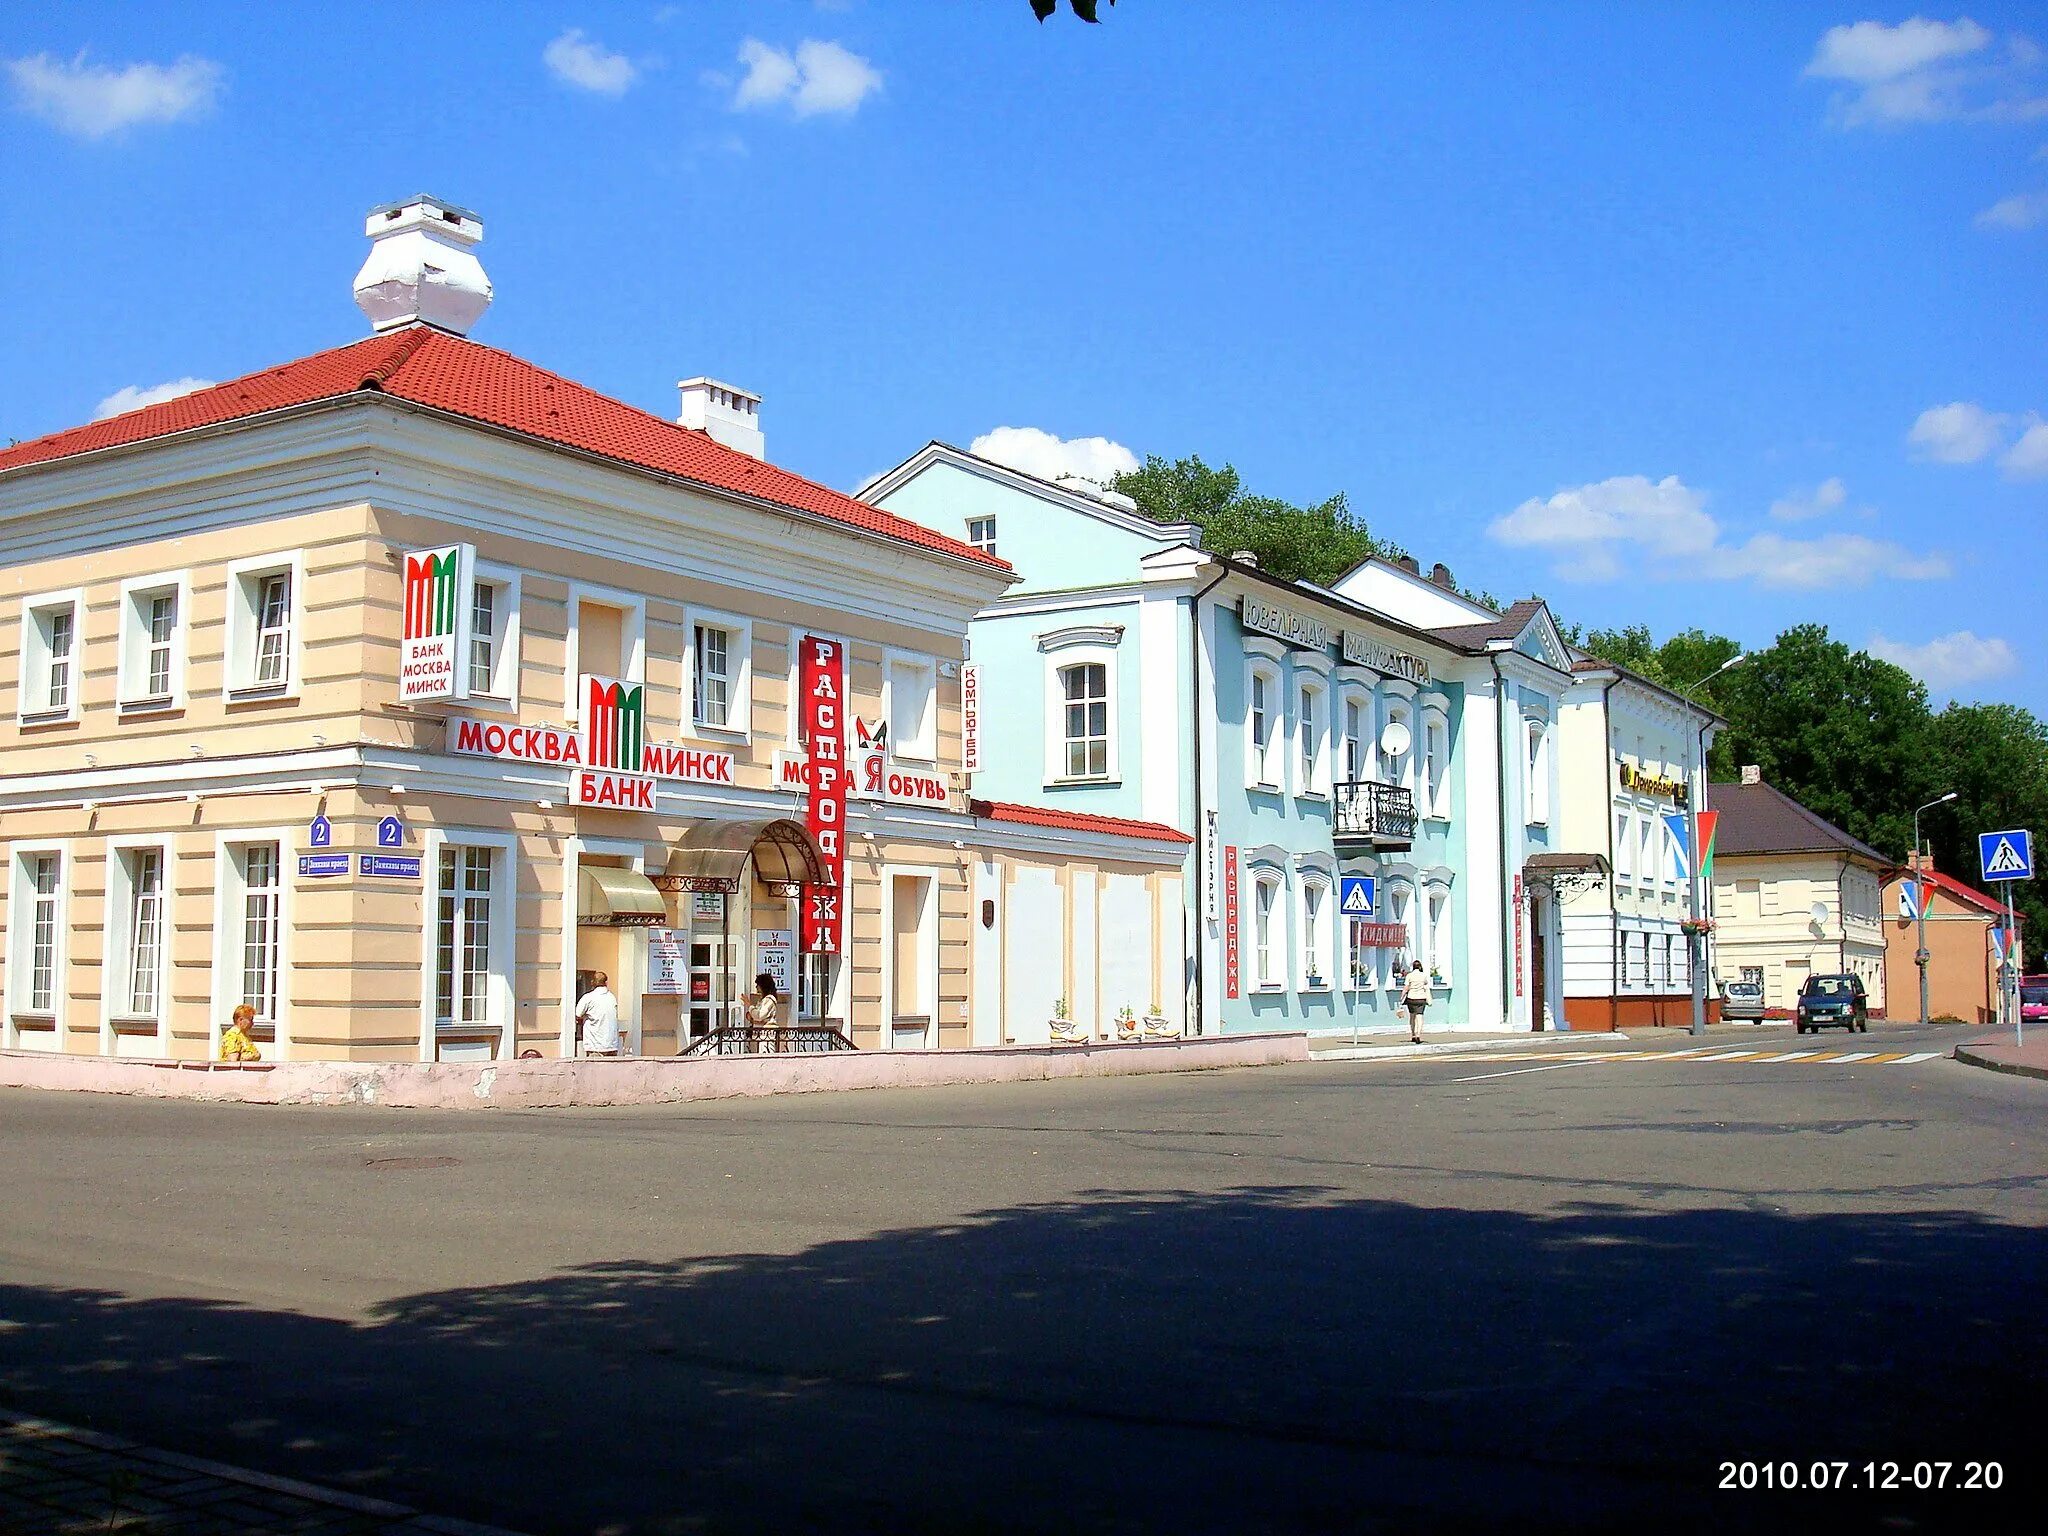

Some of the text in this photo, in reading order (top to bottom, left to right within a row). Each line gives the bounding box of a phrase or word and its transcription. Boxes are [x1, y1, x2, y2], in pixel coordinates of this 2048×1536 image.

[412, 643, 444, 659] БАНК
[403, 660, 452, 677] МОСКВА
[406, 678, 447, 695] МИНСК
[965, 668, 976, 768] КОМПЬЮТЕРЫ
[457, 721, 731, 781] МОСКВА МИНСК
[783, 754, 946, 801] МОАЯ ОБУВЬ
[580, 773, 654, 809] БАНК
[315, 823, 325, 842] 2
[385, 823, 396, 842] 2
[1228, 852, 1237, 992] РАСПРОДАЖА
[1360, 926, 1405, 945] КИДКИ!!!
